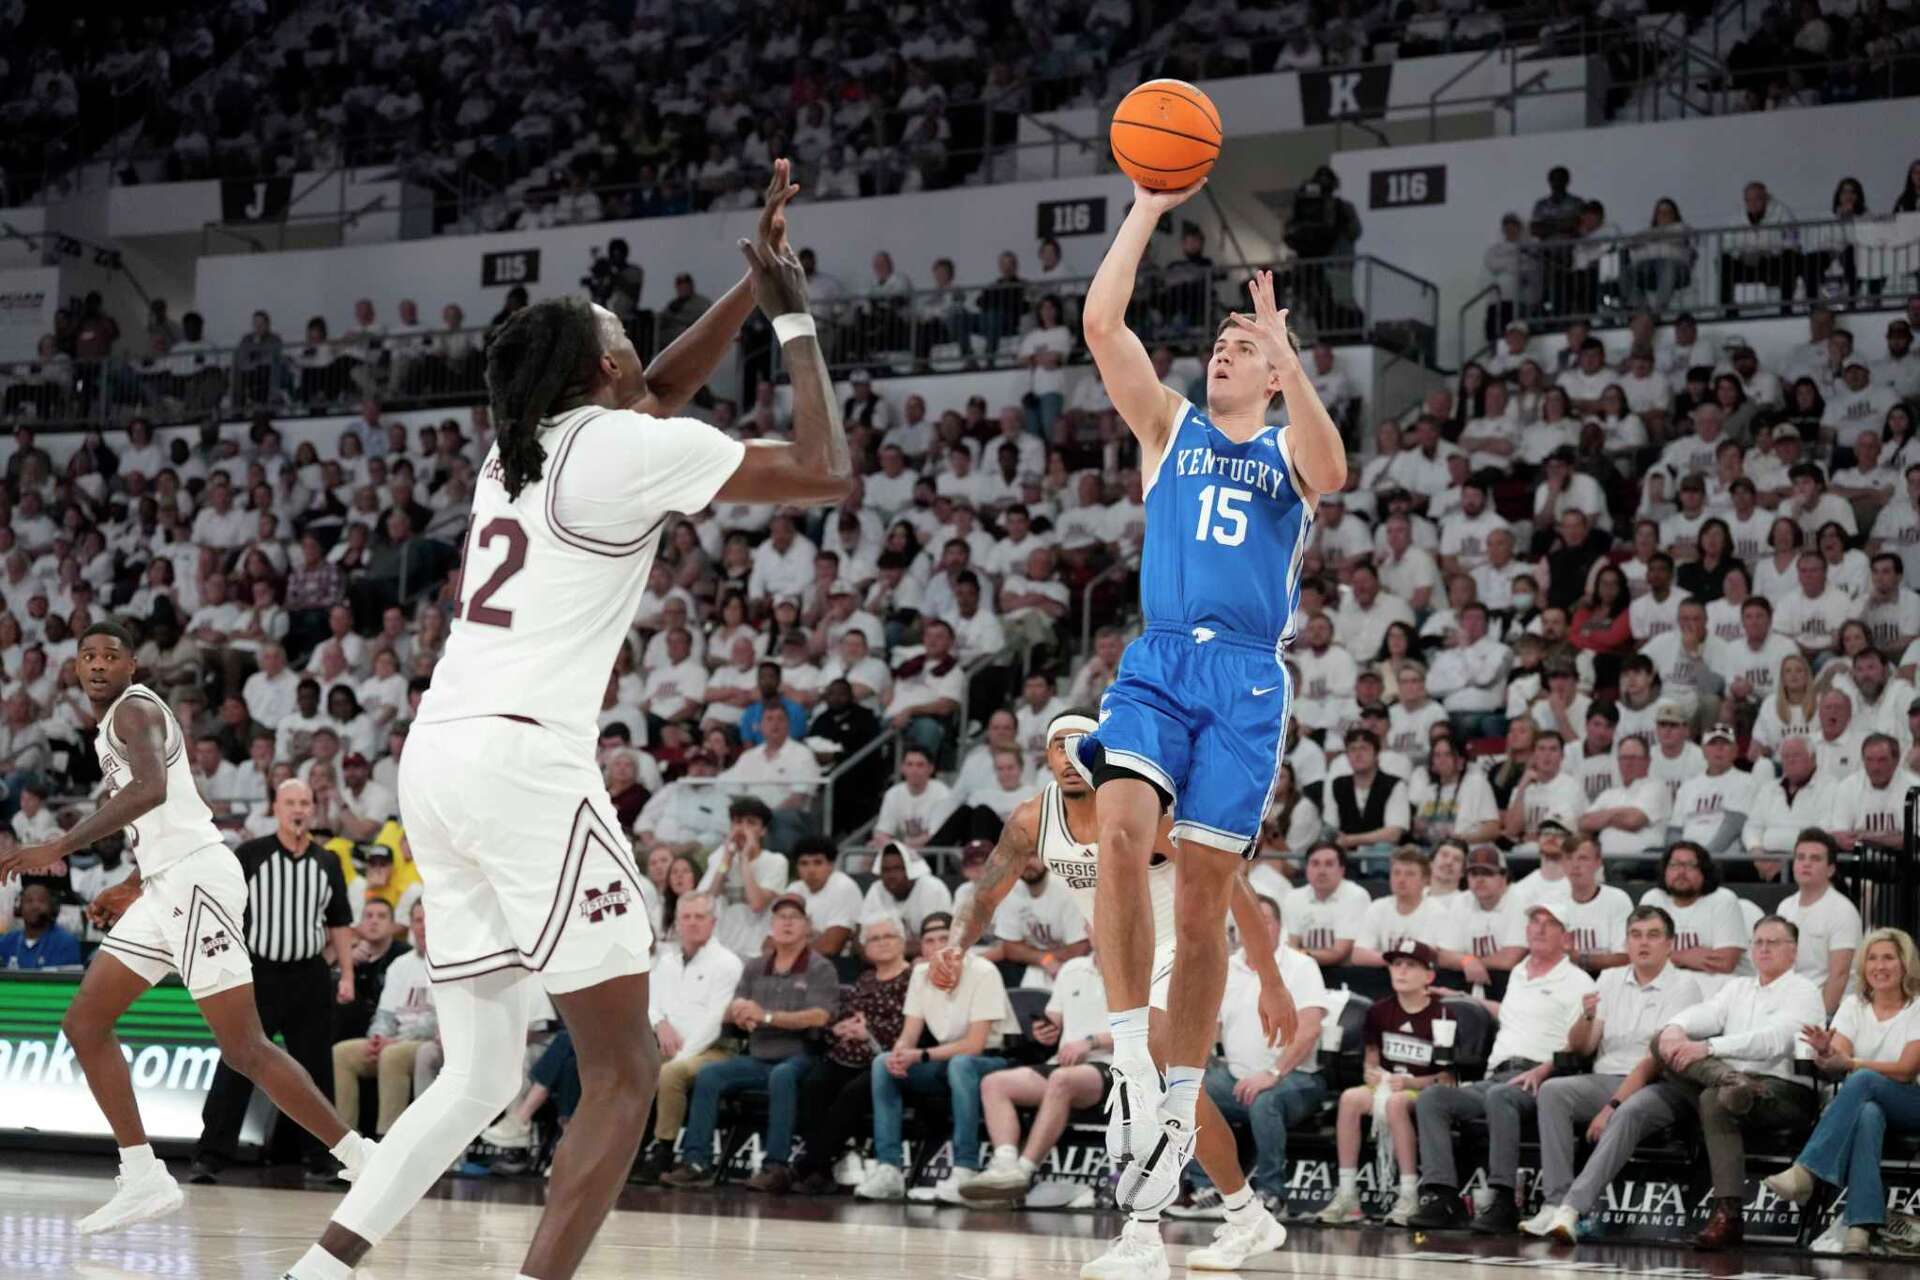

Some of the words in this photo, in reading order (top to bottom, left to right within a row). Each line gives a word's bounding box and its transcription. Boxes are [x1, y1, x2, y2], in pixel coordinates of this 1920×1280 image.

[1328, 73, 1362, 117] K
[245, 182, 268, 219] J
[1387, 173, 1428, 203] 116
[1053, 203, 1090, 232] 116
[496, 255, 528, 281] 115
[1177, 447, 1284, 499] KENTUCKY
[1195, 484, 1253, 547] 15
[1049, 862, 1098, 877] MISSIS
